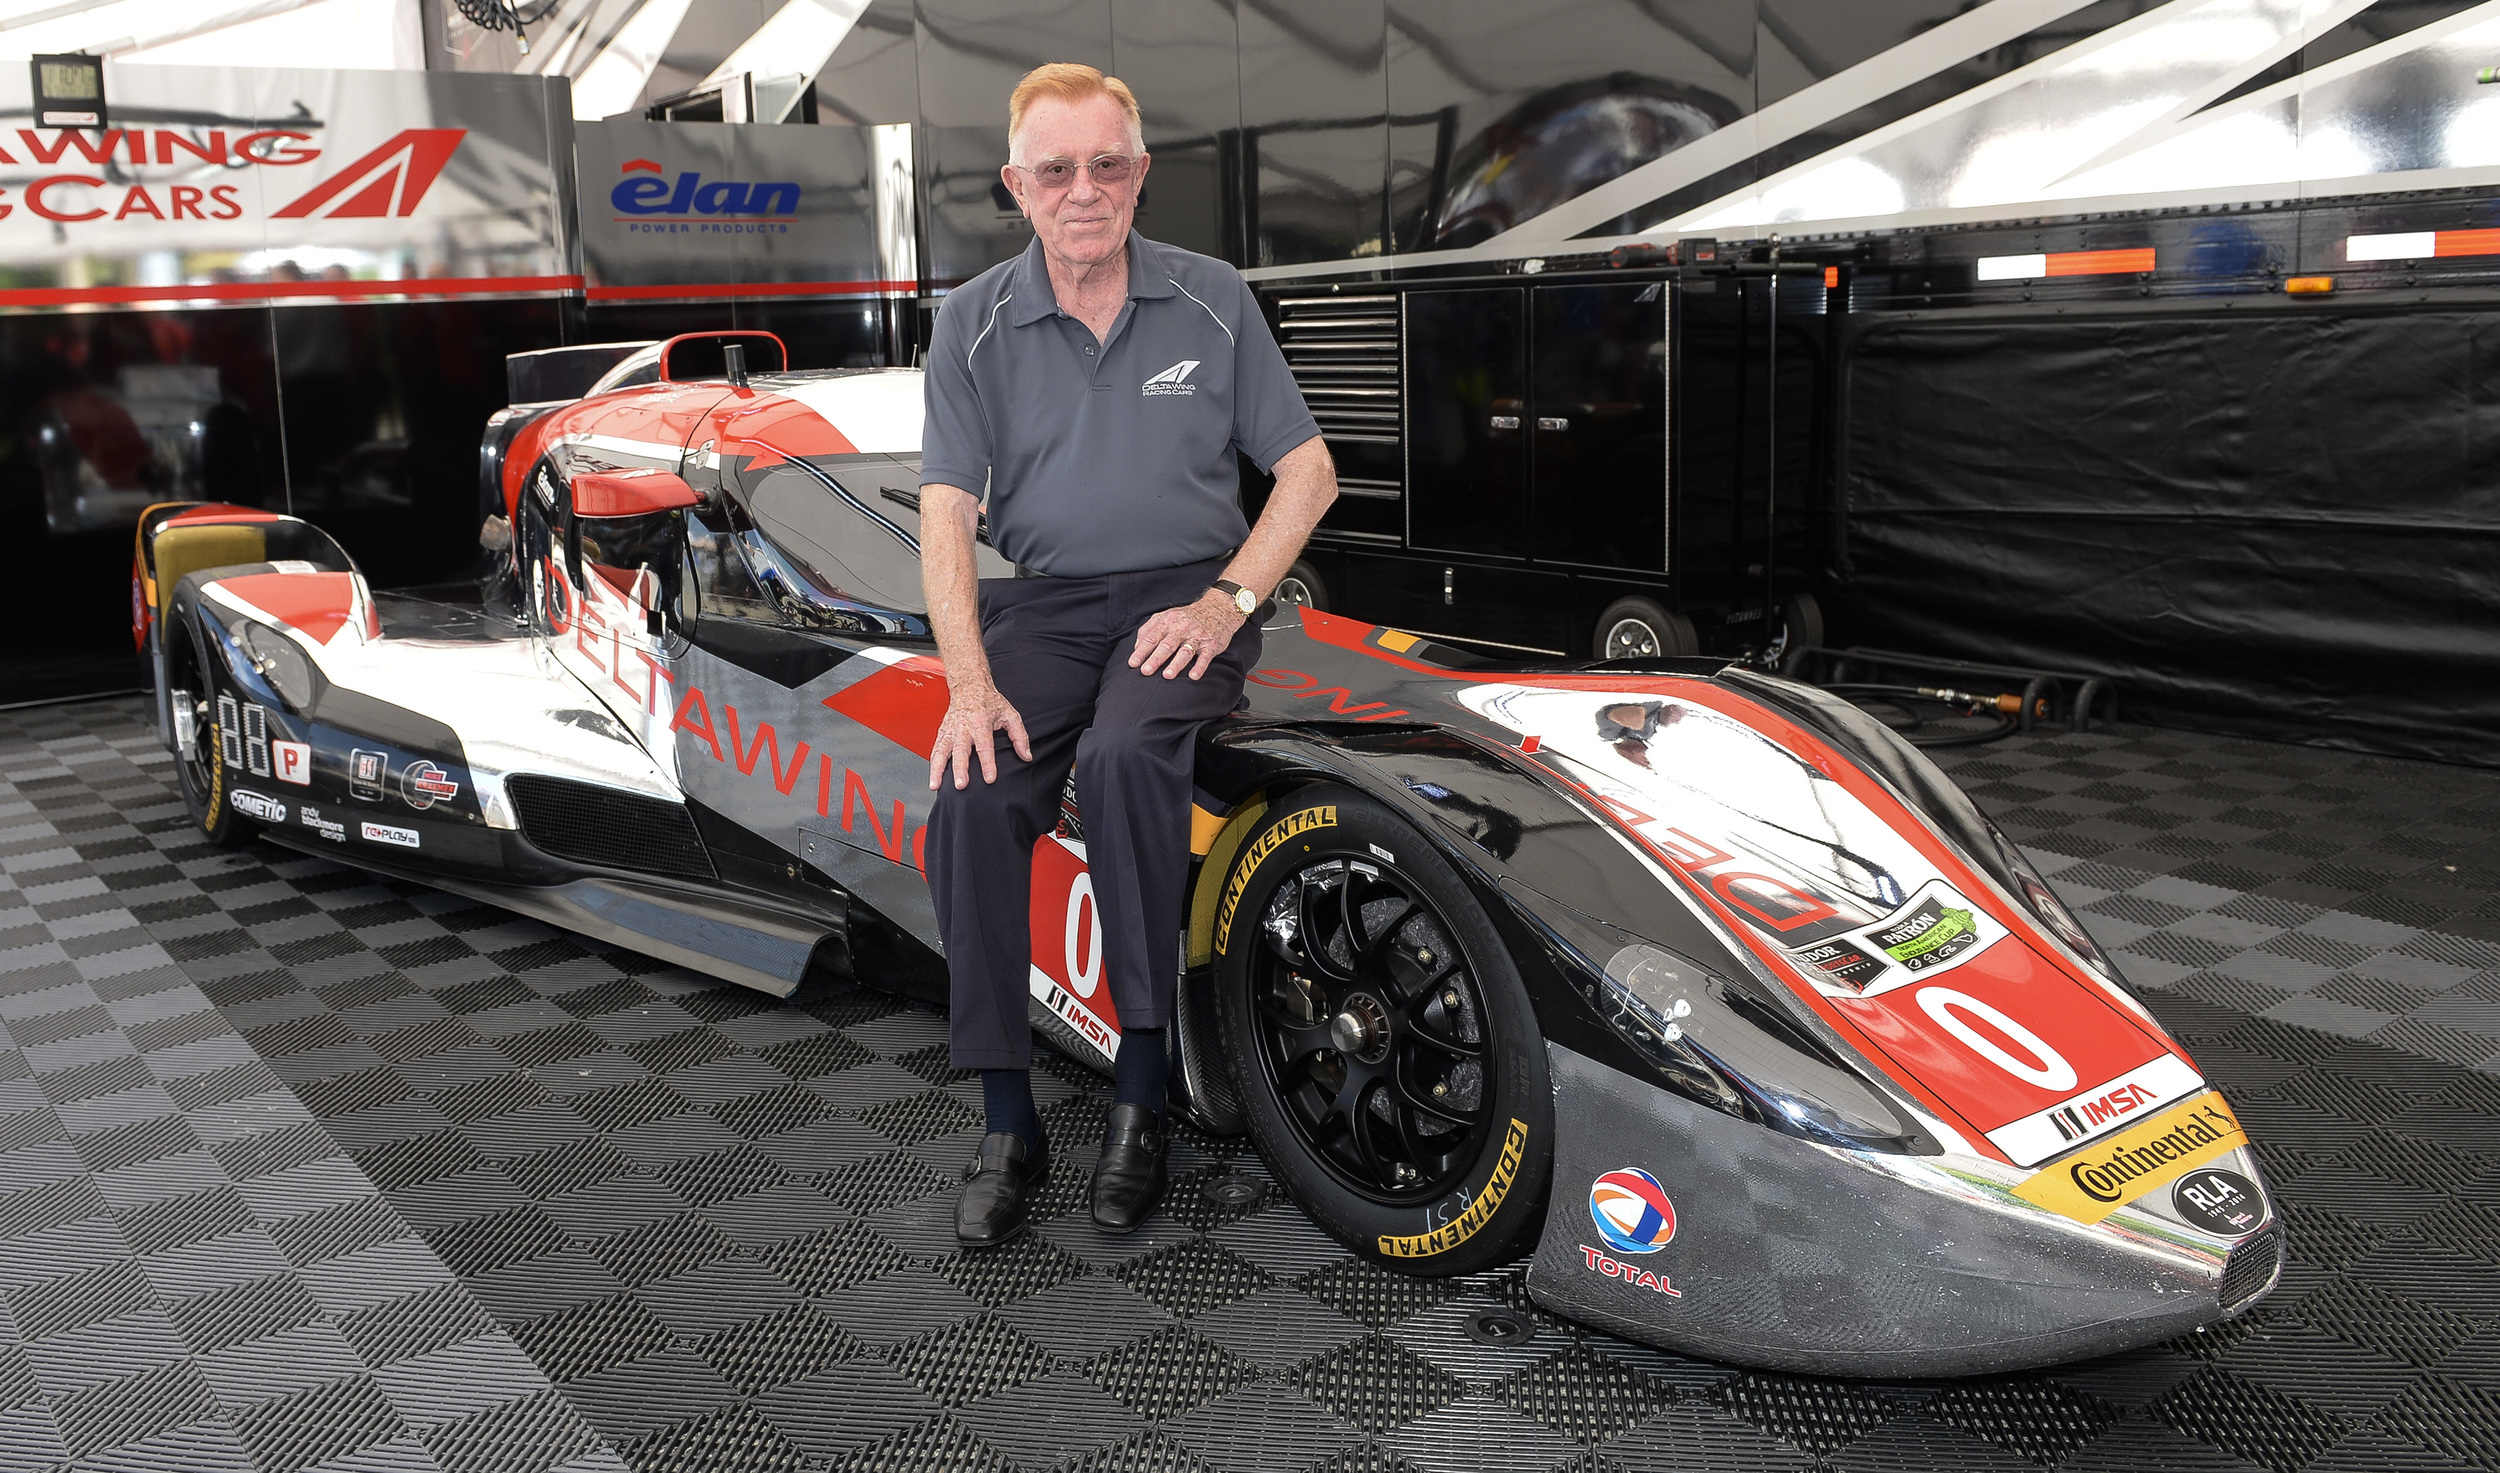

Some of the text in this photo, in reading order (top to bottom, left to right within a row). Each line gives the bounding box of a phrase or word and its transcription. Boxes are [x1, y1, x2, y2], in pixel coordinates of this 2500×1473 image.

[630, 223, 788, 234] POWER PRODUCTS
[1142, 383, 1196, 391] DELTAWING
[1142, 389, 1172, 397] RACING
[283, 748, 299, 776] P
[230, 790, 287, 822] COMETIC
[301, 806, 320, 819] andy
[301, 815, 344, 832] blackmore
[320, 829, 346, 842] design
[1352, 808, 1455, 879] EXTREME
[1216, 806, 1337, 953] CONTINENTAL
[1065, 872, 1103, 999] 0
[1881, 912, 1938, 945] PATRÓN
[1896, 923, 1947, 951] NORTH AMERICAN
[1899, 928, 1956, 958] ENDURANCE CUP
[1795, 945, 1842, 966] UDOR
[1067, 1004, 1113, 1056] IMSA
[1915, 986, 2079, 1092] 0
[2080, 1083, 2158, 1127] IMSA
[2069, 1112, 2225, 1203] Continental
[1380, 1126, 1526, 1256] CONTINENTAL
[2181, 1174, 2239, 1212] RLA
[2229, 1194, 2247, 1208] 2014
[1579, 1243, 1682, 1298] TOTAL
